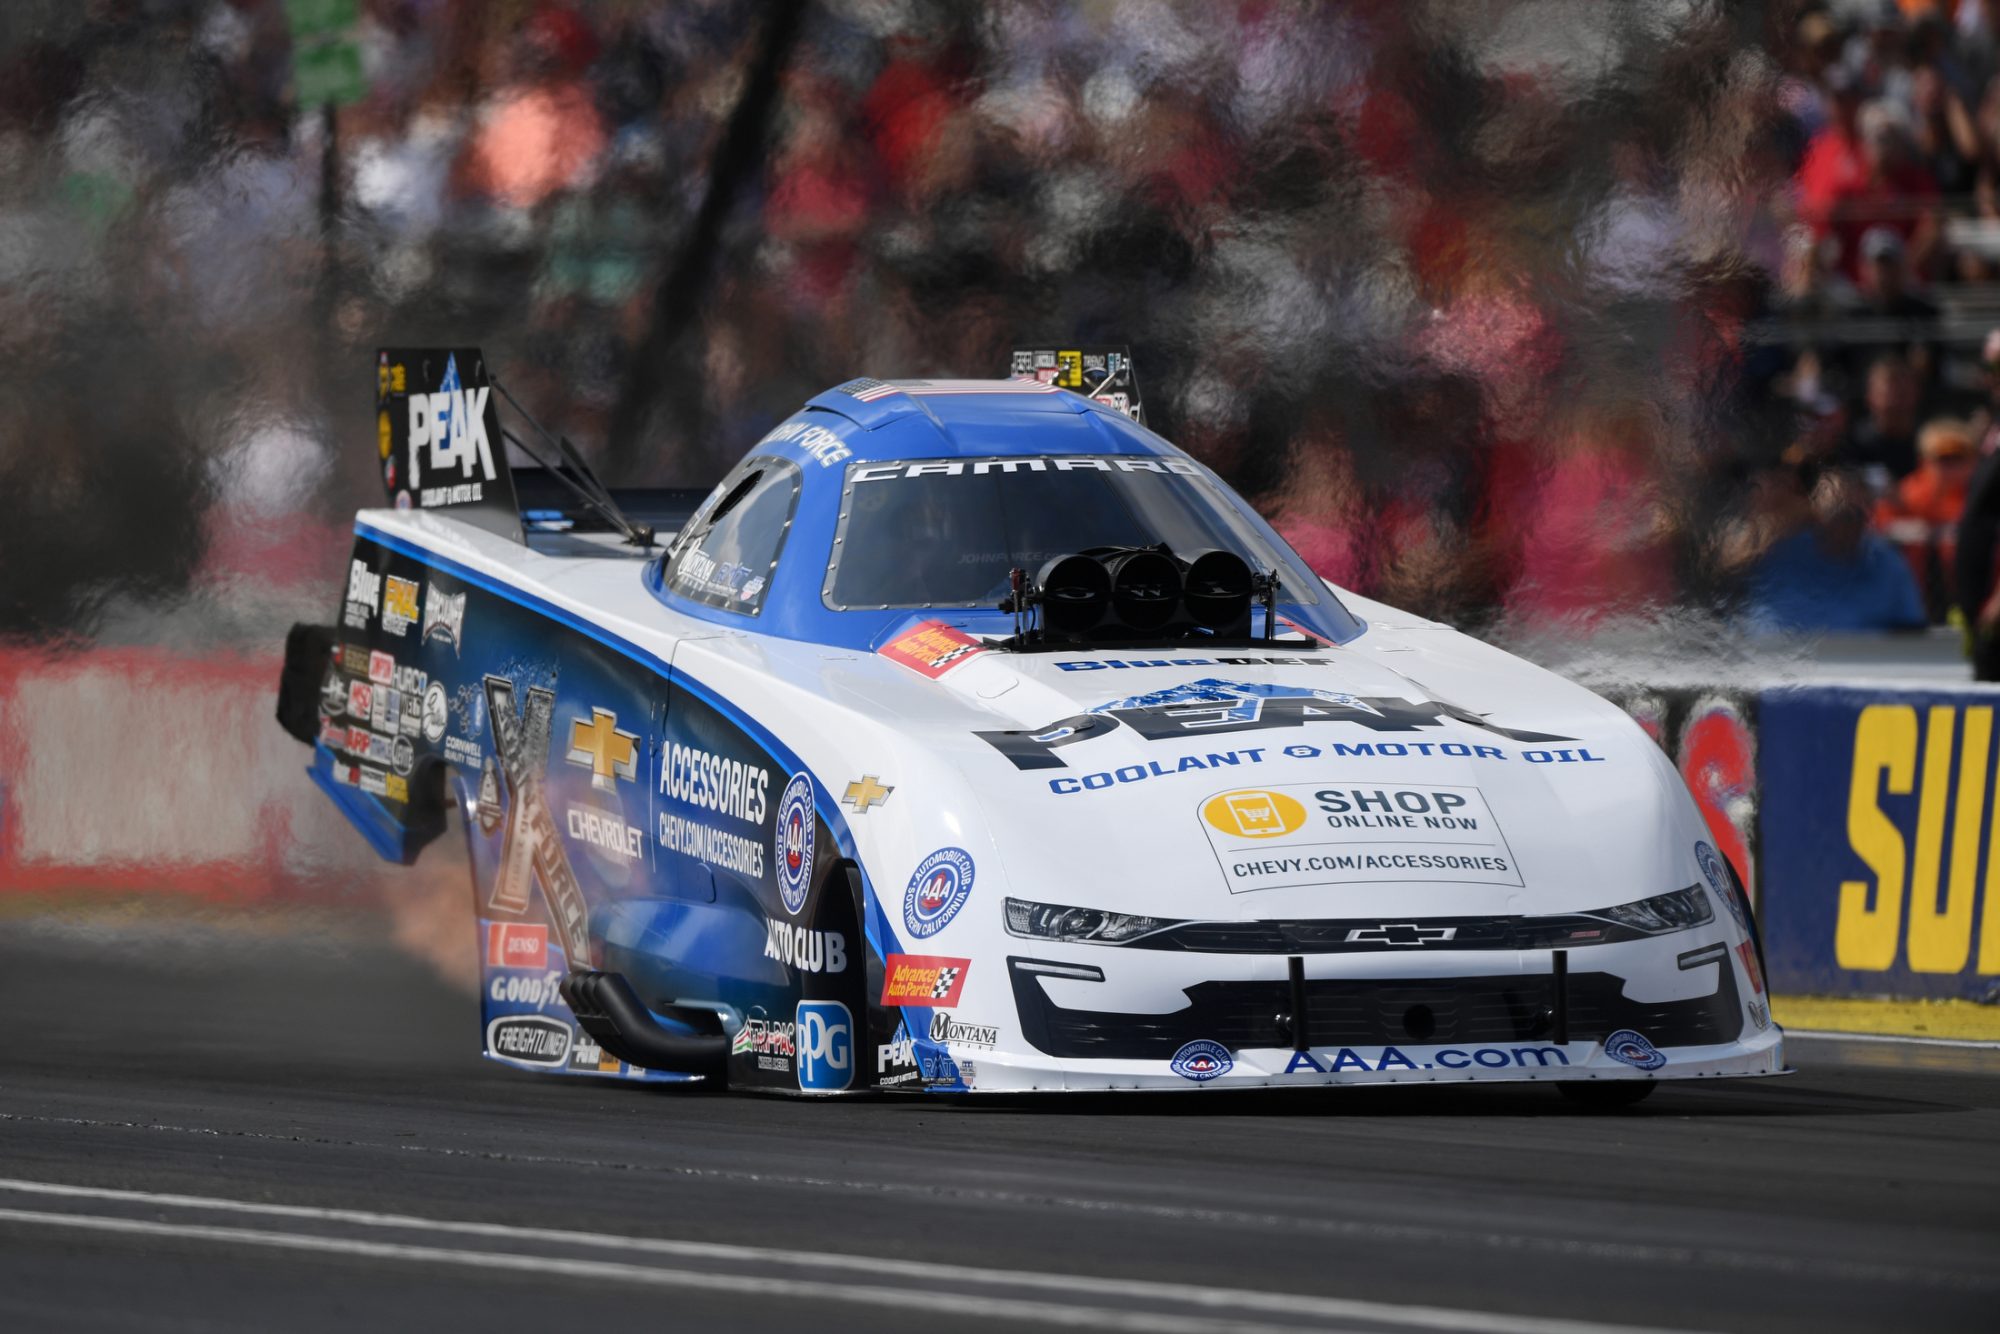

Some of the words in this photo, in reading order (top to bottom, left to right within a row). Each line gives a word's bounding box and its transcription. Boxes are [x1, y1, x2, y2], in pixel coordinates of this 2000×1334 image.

[408, 386, 497, 490] PEAK
[792, 425, 853, 468] FORCE
[850, 459, 1203, 483] CAMARO
[971, 695, 1584, 771] PEAK
[660, 740, 769, 826] ACCESSORIES
[1049, 748, 1268, 796] COOLANT
[1333, 742, 1507, 760] MOTOR
[1520, 748, 1606, 763] OIL
[1314, 789, 1467, 815] SHOP
[567, 808, 643, 860] CHEVROLET
[1327, 815, 1418, 829] ONLINE
[1424, 815, 1478, 830] NOW
[659, 812, 764, 880] CHEVY.COM/ACCESSORIES
[786, 822, 804, 857] AAA
[1834, 704, 2000, 976] SU
[915, 850, 966, 882] AUTOMOBILE
[960, 860, 971, 886] CLUB
[1233, 854, 1509, 878] CHEVY.COM/ACCESSORIES
[921, 878, 952, 901] AAA
[905, 887, 922, 935] SOUTHERN
[921, 892, 967, 936] CALIFORNIA
[508, 937, 539, 954] DENSO
[764, 916, 793, 966] AUTO
[795, 926, 848, 973] CLUB
[887, 982, 906, 997] Auto
[905, 981, 930, 997] Parts
[892, 964, 937, 983] Advance
[498, 1027, 567, 1056] FREIGHTLINER
[930, 1012, 997, 1044] MONTANA
[1175, 1043, 1217, 1064] AUTOMOBILE
[1187, 1061, 1215, 1069] AAA
[1283, 1046, 1570, 1074] AAA.com
